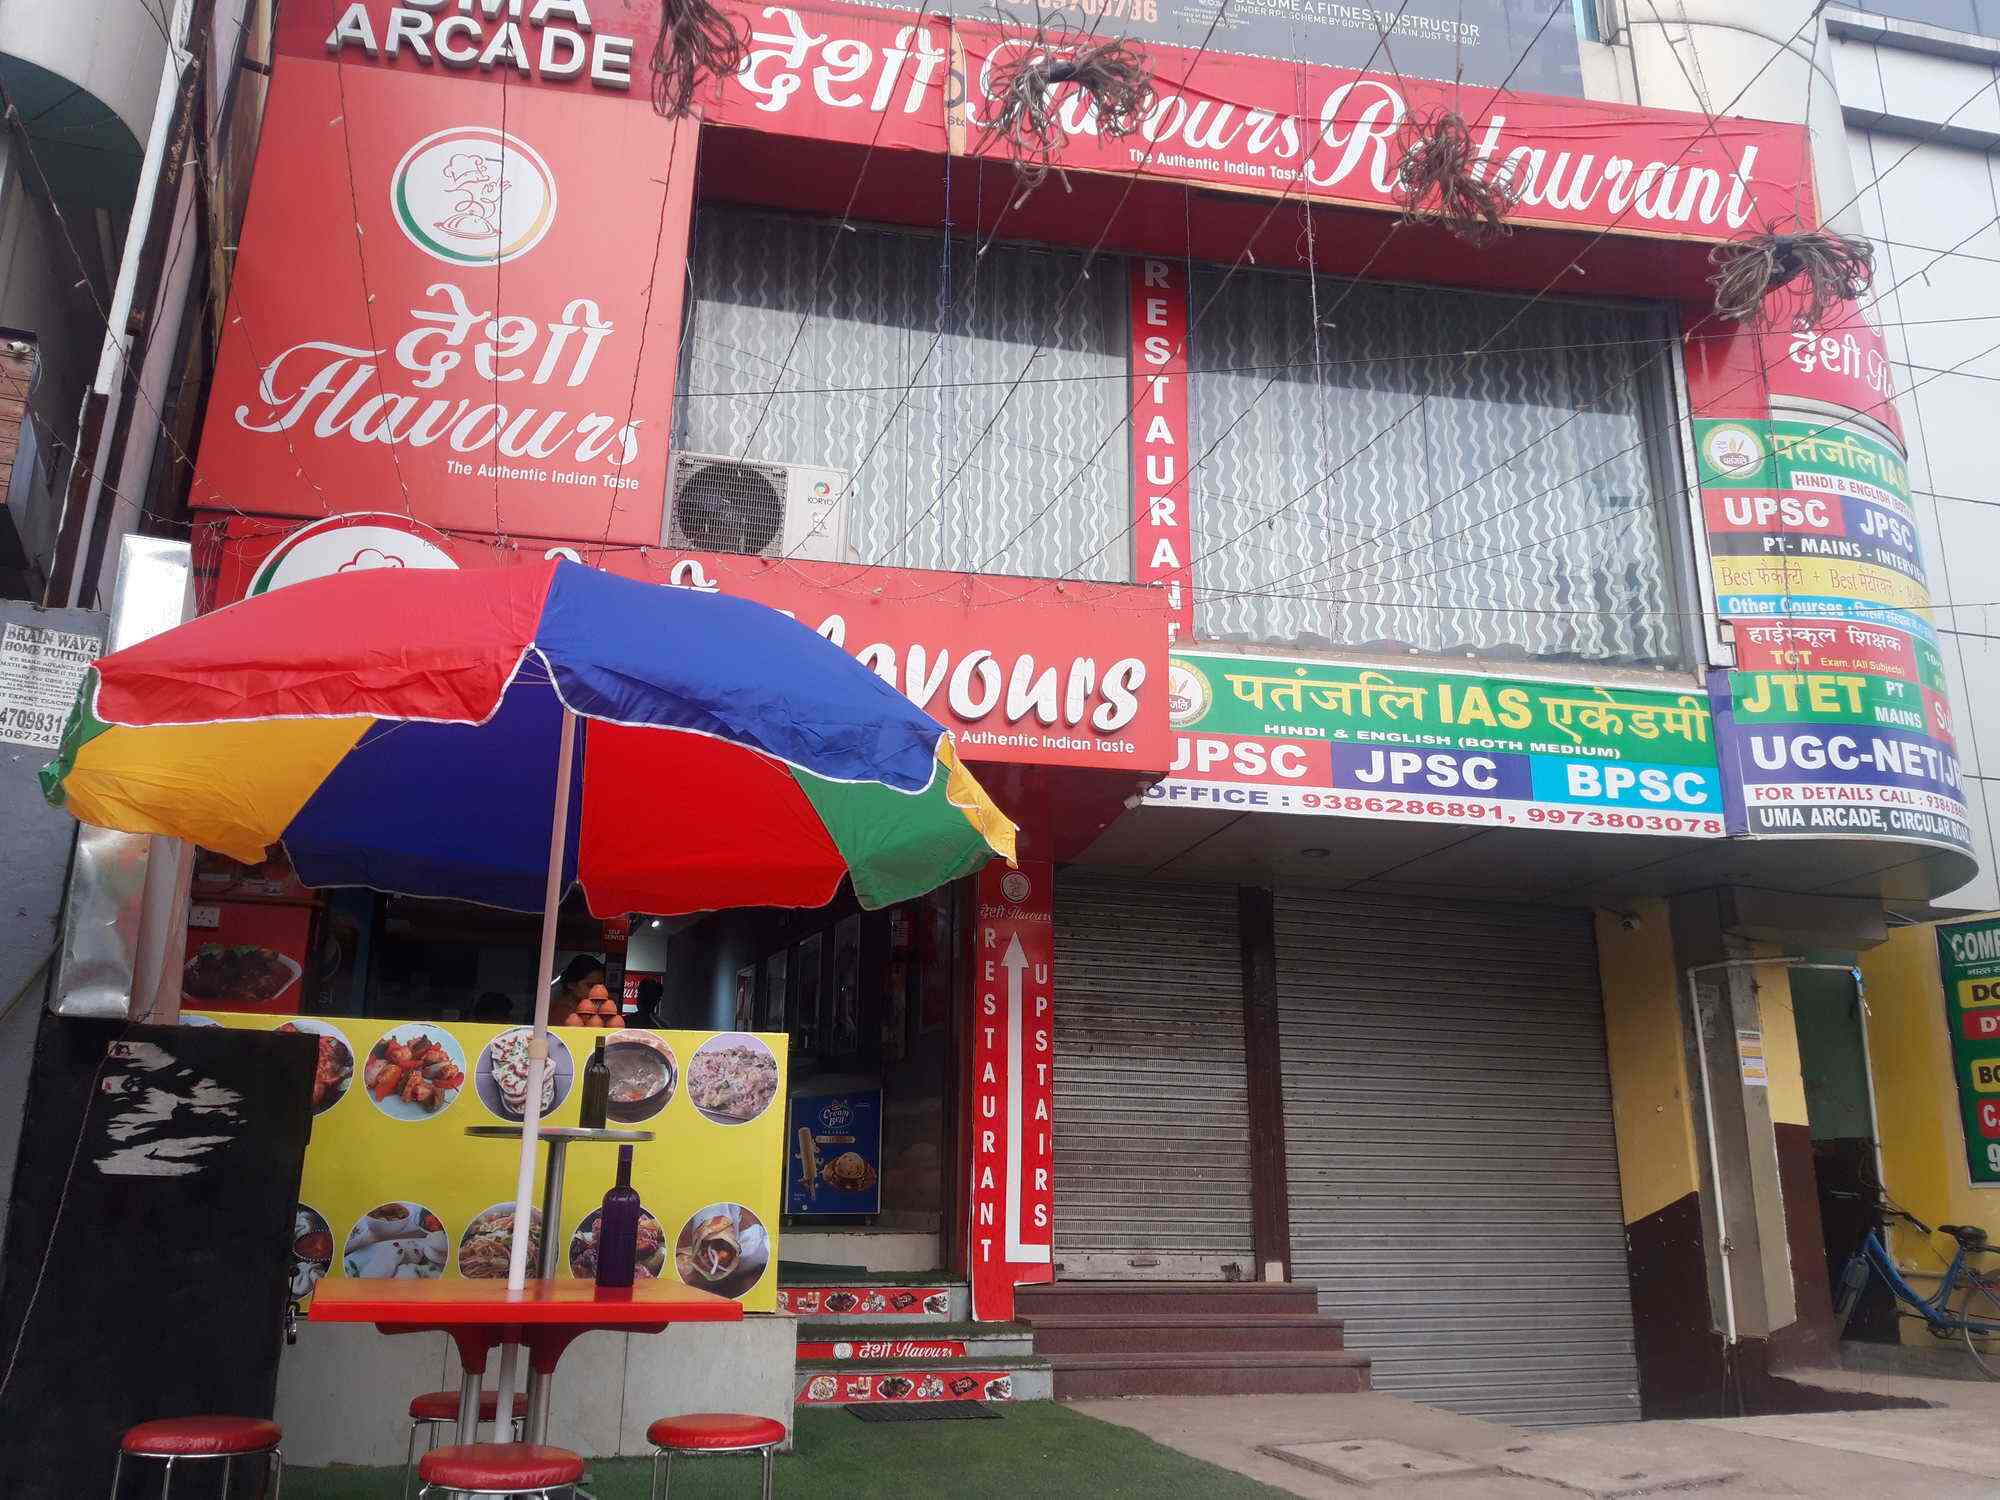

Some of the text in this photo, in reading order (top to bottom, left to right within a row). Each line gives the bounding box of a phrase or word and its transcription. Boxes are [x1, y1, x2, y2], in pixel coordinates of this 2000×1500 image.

[1304, 1, 1314, 13] A
[1318, 2, 1382, 22] FITNESS
[1385, 12, 1480, 36] INSTRUCTOR
[325, 3, 635, 90] ARCADE
[738, 7, 946, 113] देशी
[1129, 149, 1307, 181] The Authentic Indian Taste
[395, 282, 615, 389] देशी
[234, 341, 646, 466] Flavours
[1764, 429, 1882, 476] पतंजलि
[446, 460, 640, 490] The Authentic Indian Taste
[1795, 474, 1834, 489] HINDI
[1838, 479, 1846, 491] &
[1722, 496, 1831, 528] UPSC
[1859, 507, 1915, 552] JPSC
[1800, 538, 1862, 558] MAINS
[1727, 596, 1778, 615] Other
[1779, 596, 1845, 616] Courses
[7, 625, 99, 653] BRAIN WAVE
[1746, 621, 1903, 652] हाईस्कूल शिक्षक
[1742, 674, 1868, 714] JTET
[1885, 680, 1905, 698] PT
[1223, 668, 1429, 721] पतंजलि
[1437, 684, 1533, 730] IAS
[1538, 687, 1710, 745] एकेडमी
[1874, 704, 1924, 729] MAINS
[960, 730, 1039, 748] Authentic
[1042, 732, 1091, 751] Indian
[1095, 737, 1136, 754] Taste
[1263, 723, 1621, 760] HINDI & ENGLISH (BOTH MEDIUM)
[1354, 749, 1499, 791] JPSC
[1566, 763, 1709, 806] BPSC
[1144, 784, 1270, 807] OFFICE
[1526, 807, 1723, 835] 9973803078
[1755, 786, 1795, 800] FOR
[1802, 787, 1874, 802] DETAILS
[1879, 788, 1915, 803] CALL
[1759, 807, 1805, 828] UMA
[1810, 807, 1889, 832] ARCADE,
[1890, 809, 1951, 838] CIRCULAR
[978, 926, 998, 1264] RESTAURANT
[1032, 962, 1050, 1229] UPSTAIRS
[859, 1341, 953, 1359] देशी Flavours
